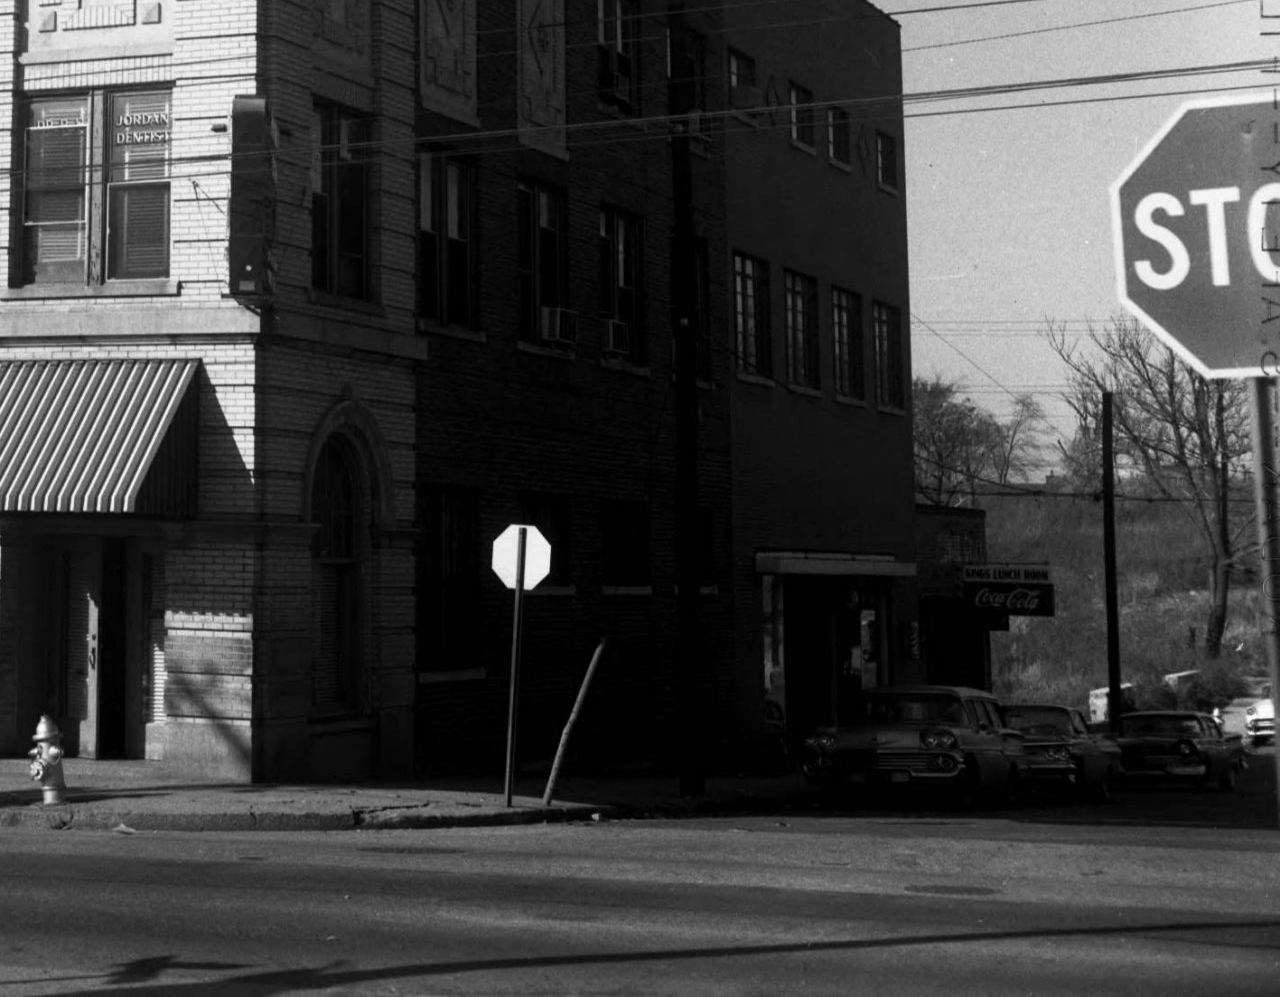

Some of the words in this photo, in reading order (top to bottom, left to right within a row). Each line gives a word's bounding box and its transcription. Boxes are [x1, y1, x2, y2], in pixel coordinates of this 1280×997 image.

[115, 112, 169, 127] JORDAN
[115, 130, 171, 145] DENTIST
[1133, 184, 1280, 292] STO
[993, 569, 1020, 580] LUNCH
[1024, 569, 1049, 580] ROOM
